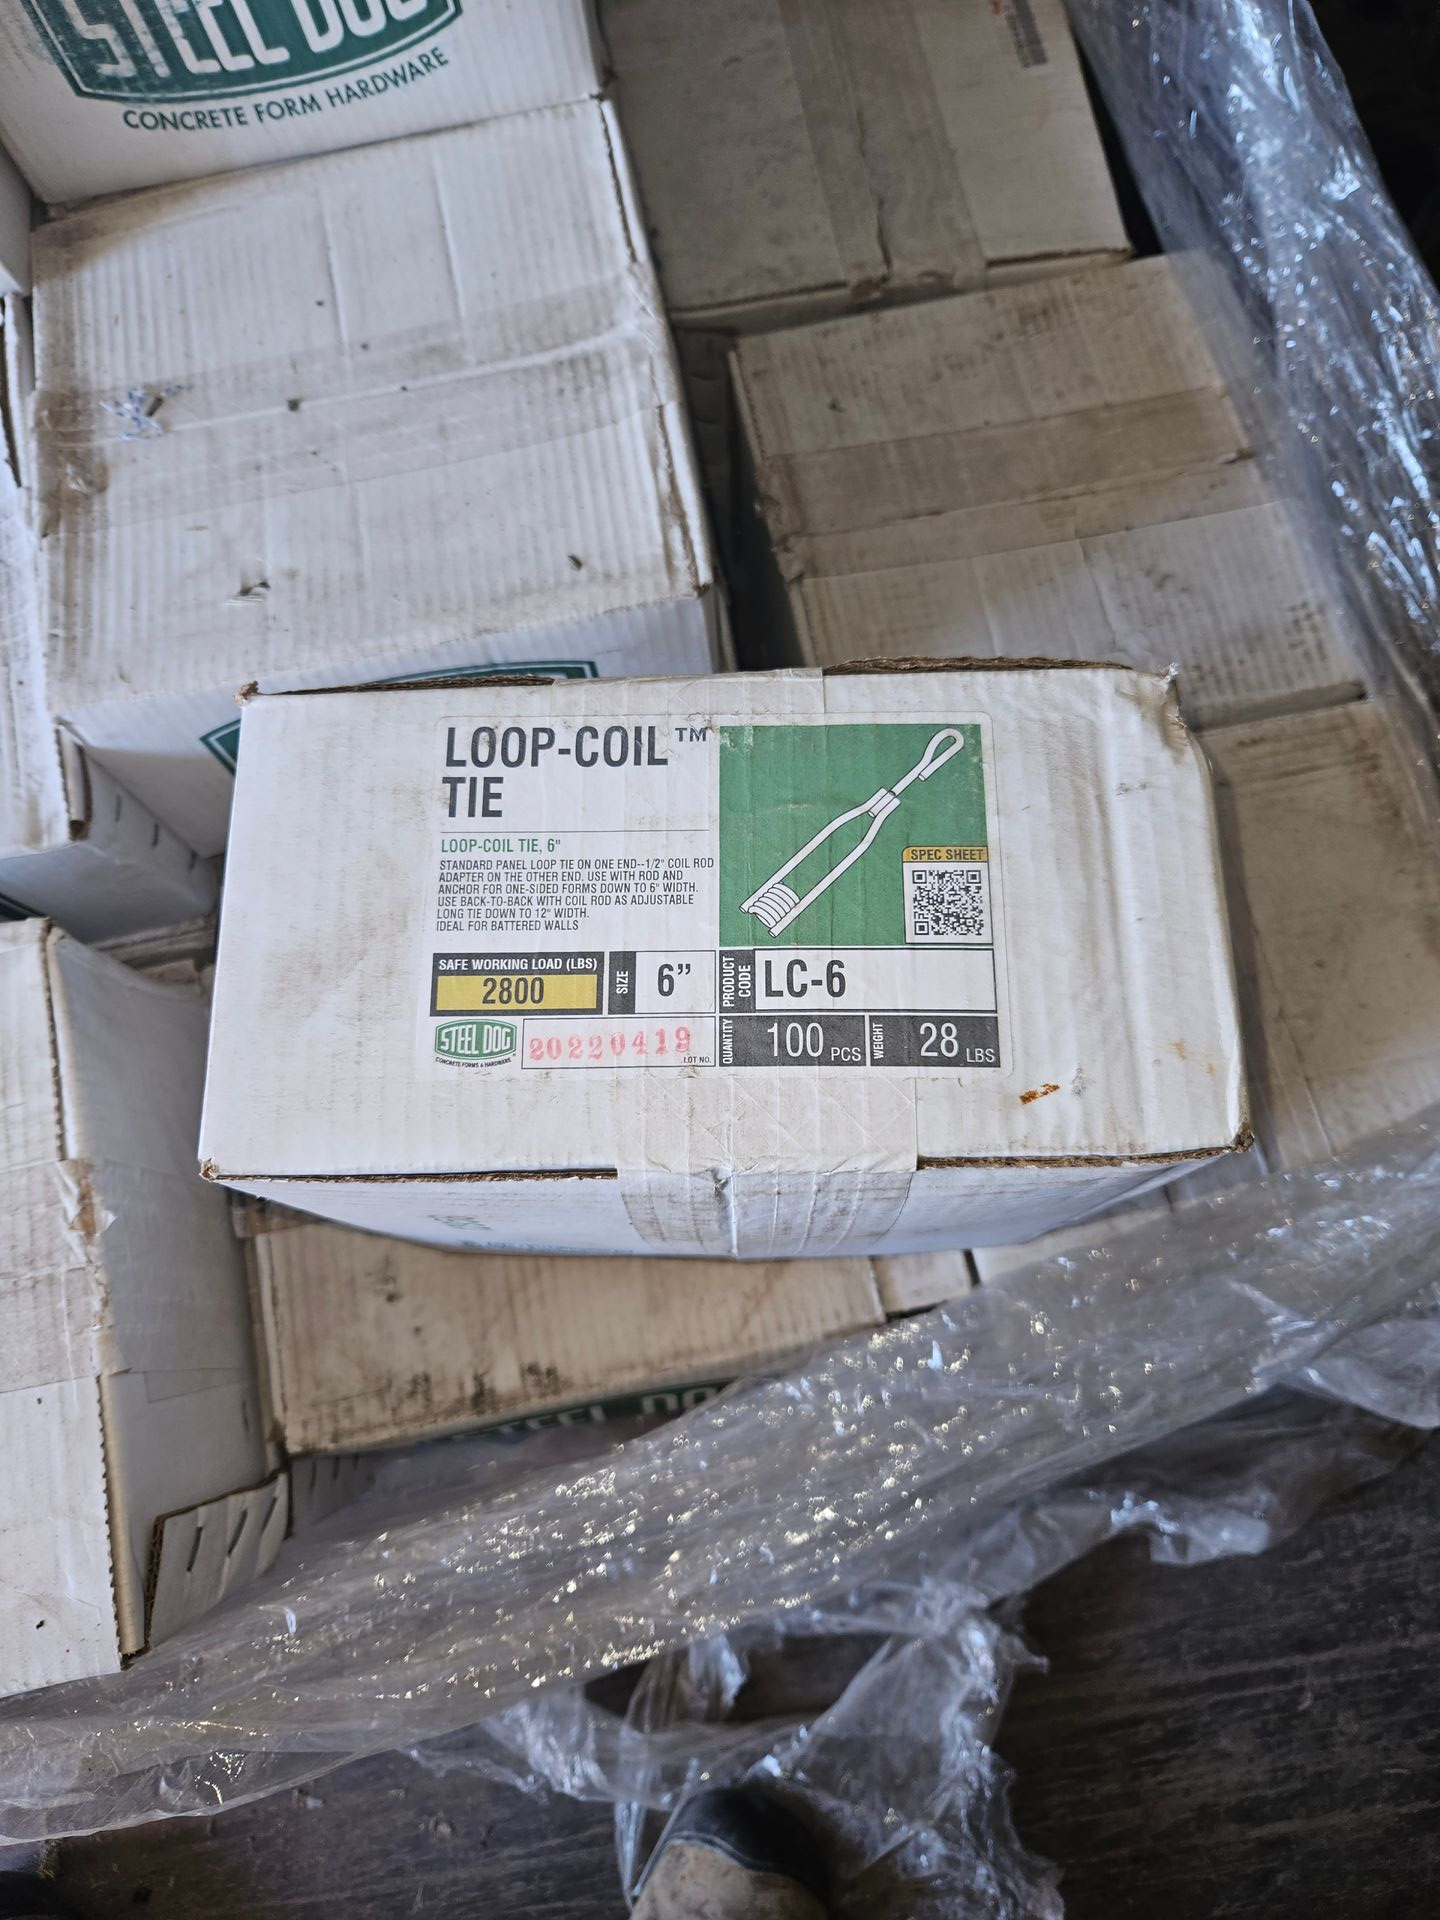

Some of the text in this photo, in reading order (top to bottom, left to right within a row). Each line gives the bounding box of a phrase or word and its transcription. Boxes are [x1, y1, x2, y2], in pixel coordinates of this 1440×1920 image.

[123, 47, 449, 131] CONCRETE FORM HARDWARE
[445, 726, 668, 767] LOOP-COIL
[442, 776, 504, 818] TIE
[441, 838, 561, 855] LOOP-COIL TIE, 6"
[911, 849, 983, 861] SPEC SHEET
[439, 870, 683, 883] ADAPTER ON THE OTHER END. USE WITH ROD AND
[440, 858, 714, 871] STANDARD PANEL LOOP TIE ON ONE END--1/2" COIL ROD
[437, 895, 694, 906] USE BACK-TO-BACK WITH COIL ROD AS ADJUSTABLE
[438, 882, 699, 894] ANCHOR FOR ONE-SIDED FORMS DOWN TO 6" WIDTH.
[436, 920, 579, 932] IDEAL FOR BATTERED WALLS
[437, 908, 590, 919] LONG TIE DOWN TO 12" WIDTH.
[439, 957, 598, 971] SAFE WORKING LOAD (LBS)
[482, 977, 545, 1005] 2800
[615, 969, 629, 995] SIZE
[722, 956, 735, 1007] PRODUCT
[738, 964, 751, 998] CODE
[764, 959, 847, 998] LC-6
[440, 1024, 511, 1054] STEEL DOG
[529, 1026, 692, 1060] 20220419
[722, 1018, 733, 1064] QUANTITY
[767, 1022, 861, 1062] 100 PCS
[873, 1022, 884, 1059] WEIGHT
[919, 1022, 995, 1063] 28 LBS
[435, 1056, 461, 1067] CONCRETE
[484, 1057, 512, 1067] HARDWARE
[699, 1055, 712, 1063] NO.
